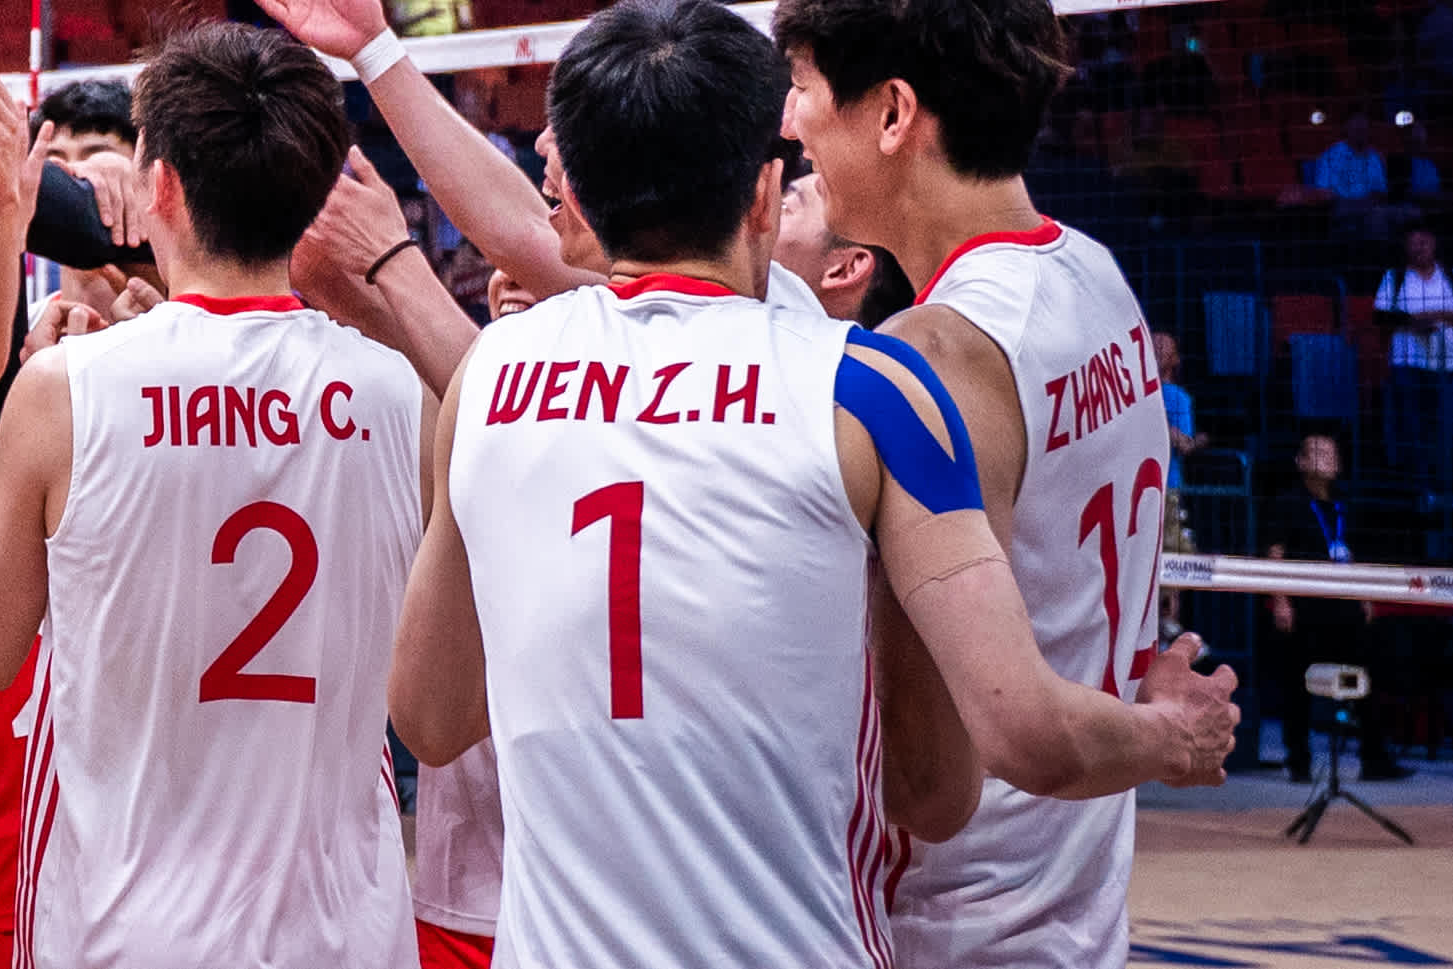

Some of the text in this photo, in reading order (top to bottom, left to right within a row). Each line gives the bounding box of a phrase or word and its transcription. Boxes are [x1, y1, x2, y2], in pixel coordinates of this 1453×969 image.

[142, 381, 371, 448] JIANG C.
[485, 360, 776, 426] WEN Z.H.
[1045, 342, 1136, 453] ZHANG
[199, 501, 318, 704] 2
[571, 481, 644, 719] 1
